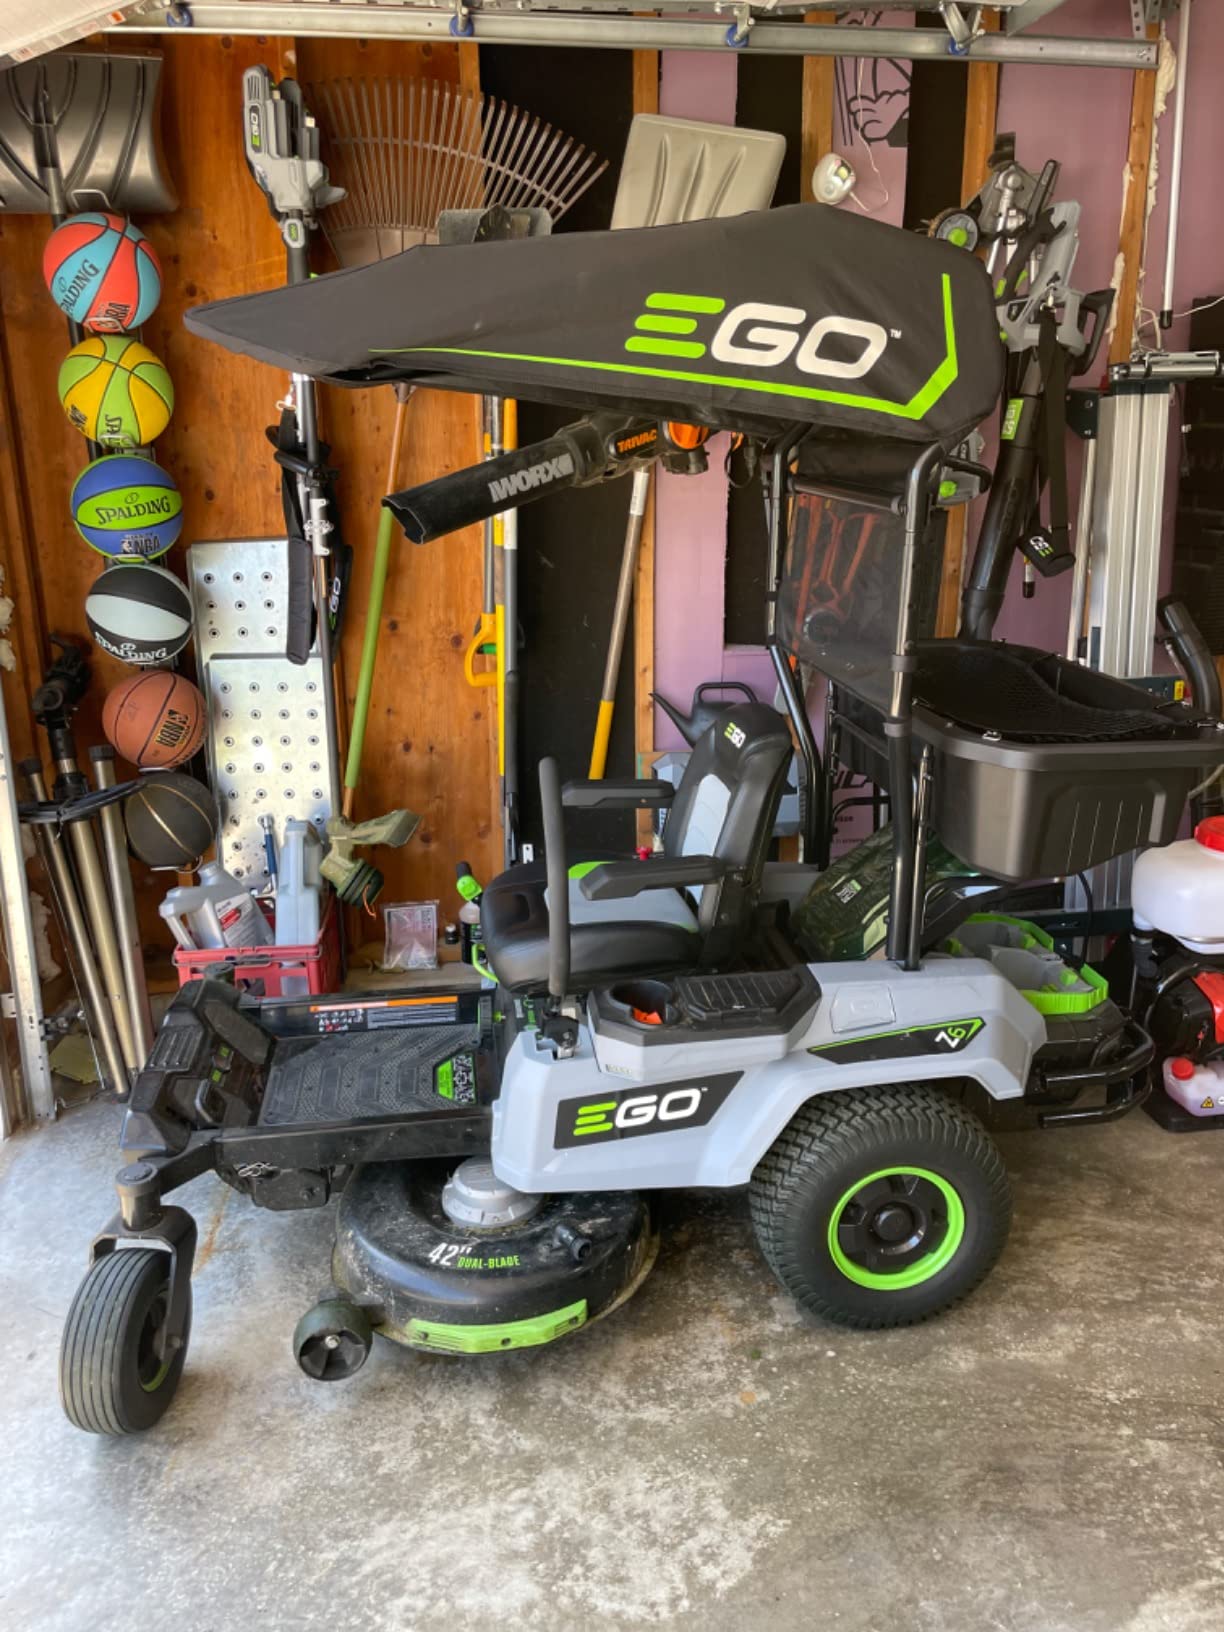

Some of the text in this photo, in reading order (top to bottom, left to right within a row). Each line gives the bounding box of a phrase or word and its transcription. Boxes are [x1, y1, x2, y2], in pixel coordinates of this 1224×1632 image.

[60, 258, 101, 314] PALDING
[624, 292, 888, 379] EGO
[617, 429, 658, 453] TRIVAC
[488, 452, 575, 503] WORX
[95, 495, 172, 525] SPALDING
[573, 1088, 702, 1137] EGO
[457, 1254, 521, 1270] DUAL-BLADE
